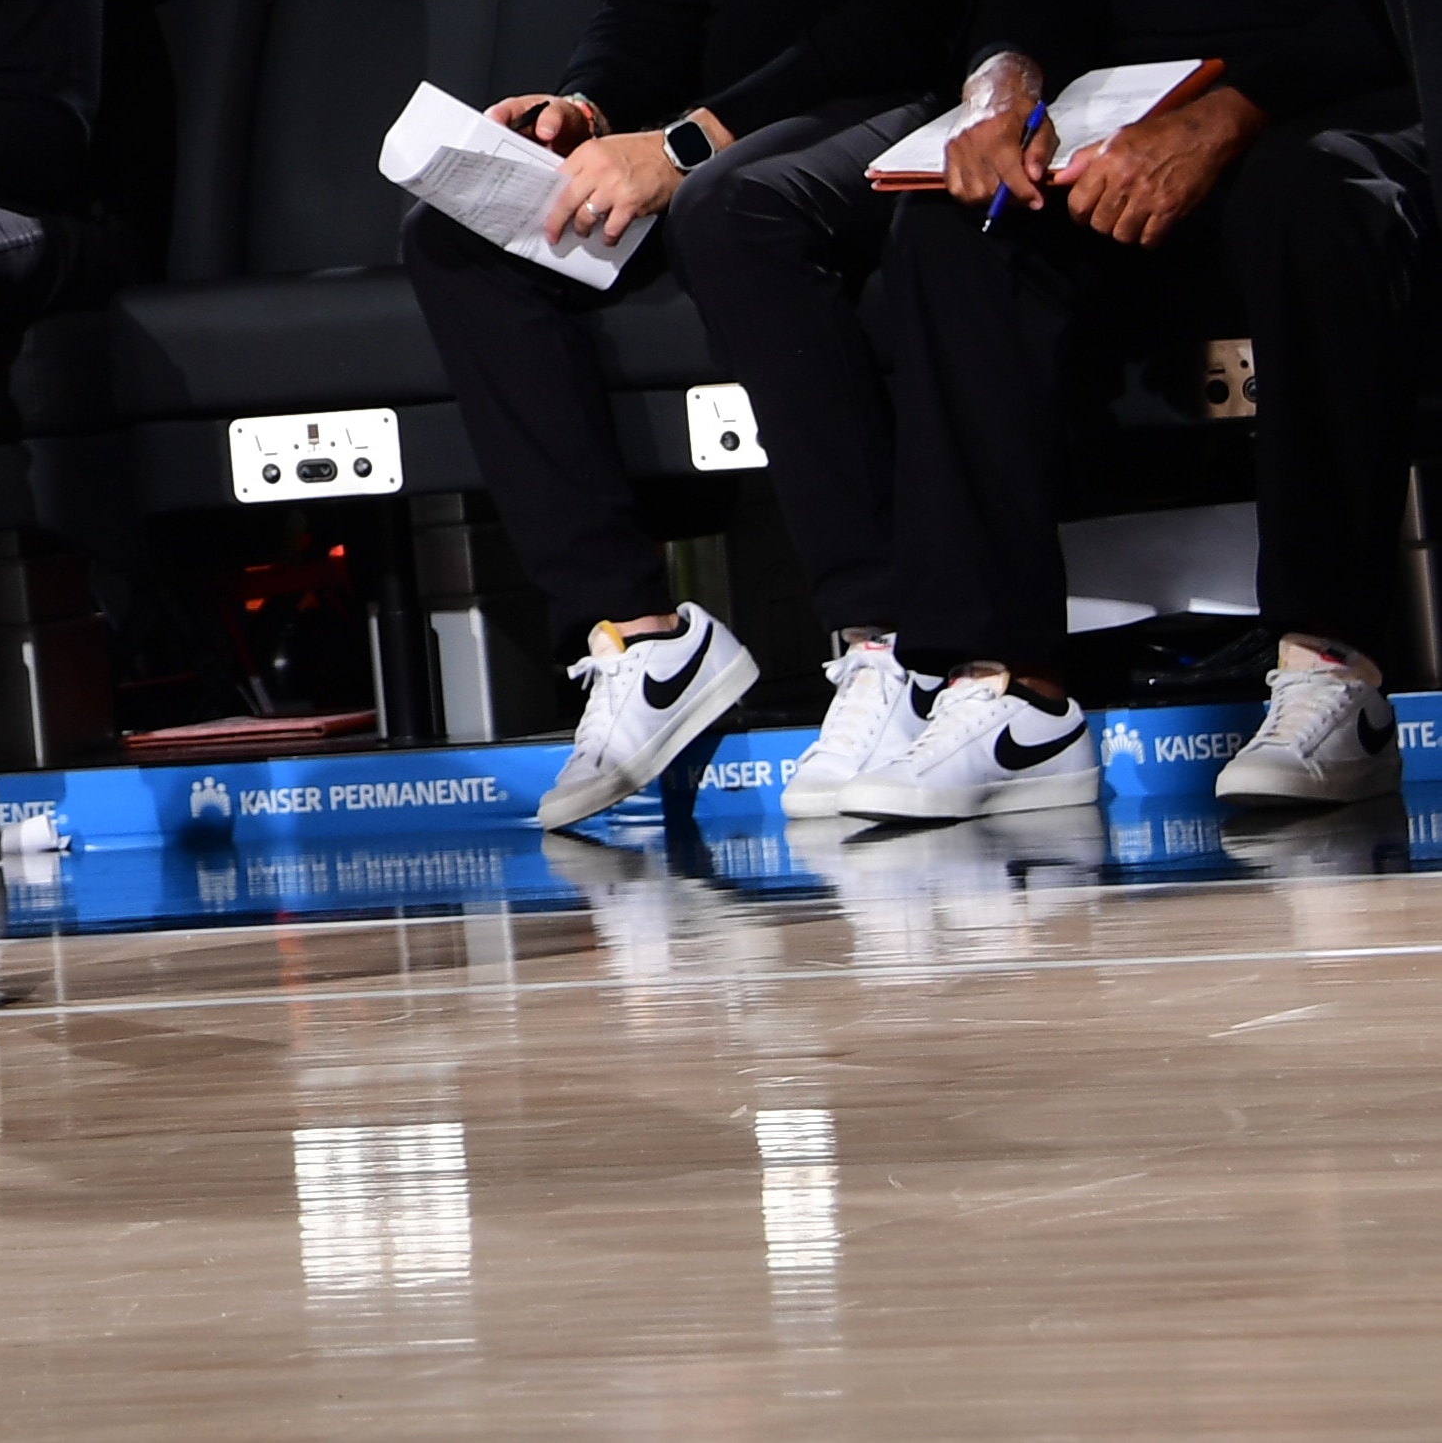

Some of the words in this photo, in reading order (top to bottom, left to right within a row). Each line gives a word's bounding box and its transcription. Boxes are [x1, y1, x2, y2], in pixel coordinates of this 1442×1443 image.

[1154, 731, 1242, 763] KAISER
[240, 786, 322, 815] KAISER
[329, 776, 496, 811] PERMANENTE
